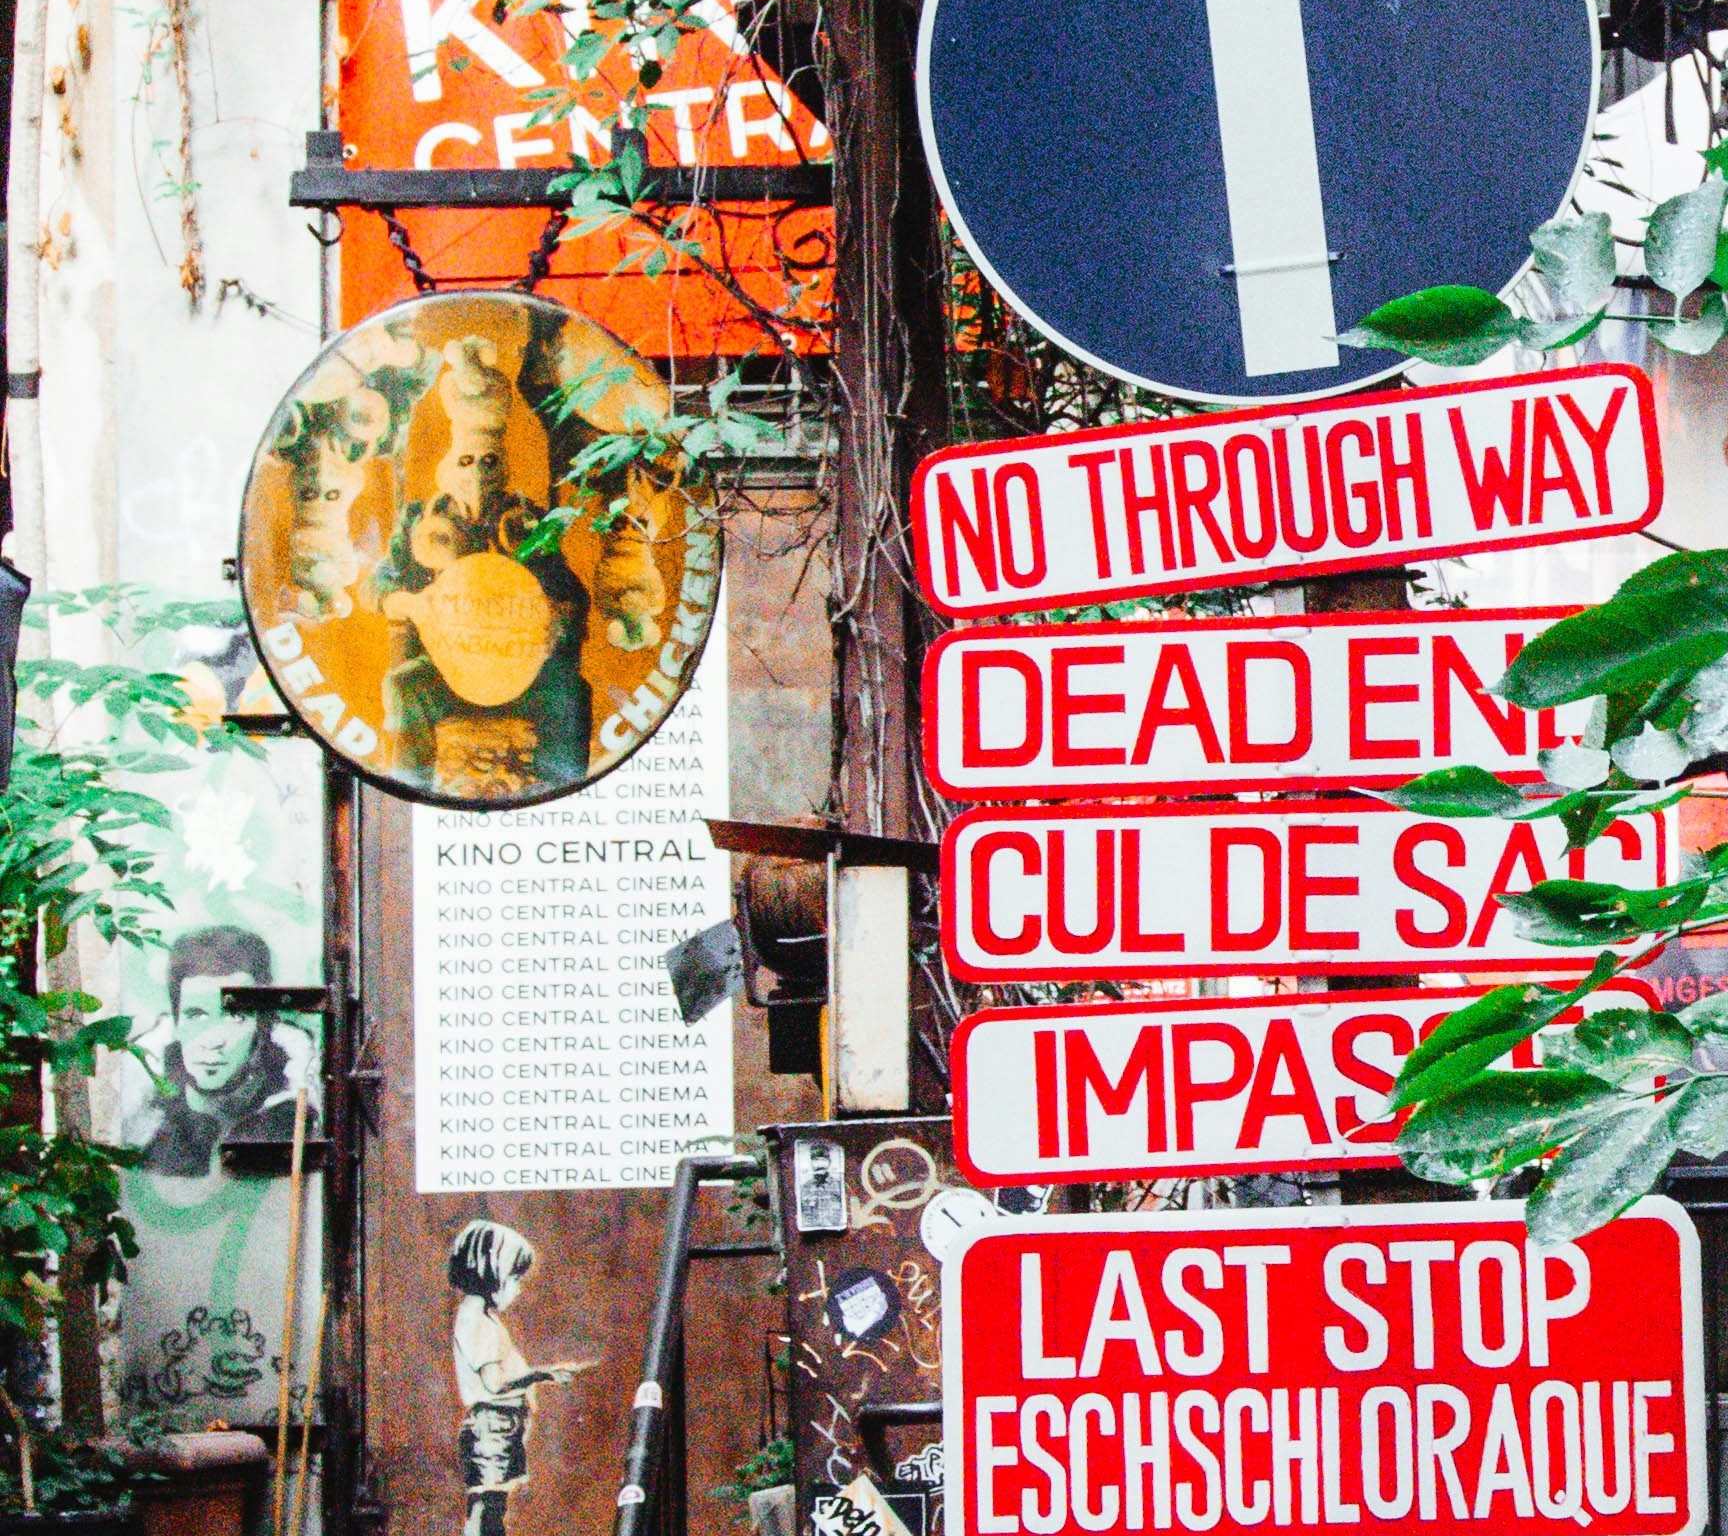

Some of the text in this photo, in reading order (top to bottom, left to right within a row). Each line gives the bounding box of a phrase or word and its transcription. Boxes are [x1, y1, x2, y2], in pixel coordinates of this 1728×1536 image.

[414, 79, 834, 171] CENTR
[935, 386, 1629, 598] NO THROUGH WAY
[264, 621, 378, 756] DEAD
[961, 641, 1312, 769] DEAD
[616, 783, 705, 799] CINEMA
[437, 808, 705, 829] KINO CENTRAL CINEMA
[437, 838, 706, 866] KINO CENTRAL
[438, 875, 705, 896] KINO CENTRAL CINEMA
[970, 827, 1185, 955] CUL
[1210, 824, 1361, 953] DE
[438, 901, 705, 922] KINO CENTRAL CINEMA
[439, 928, 701, 949] KINO CENTRAL CINEM
[439, 954, 667, 975] KINO CENTRAL CINE
[439, 980, 671, 1001] KINO CENTRAL CINE
[439, 1007, 708, 1028] KINO CENTRAL CINE
[440, 1033, 708, 1054] KINO CENTRAL CINEMA
[440, 1060, 708, 1081] KINO CENTRAL CINEMA
[1034, 1005, 1585, 1159] IMPAS
[440, 1086, 709, 1107] KINO CENTRAL CINEMA
[440, 1112, 709, 1133] KINO CENTRAL CINEMA
[441, 1144, 495, 1160] KINO
[503, 1142, 611, 1158] CENTRAL
[441, 1165, 671, 1186] KINO CENTRAL CINE
[1020, 1243, 1291, 1382] LAST
[1323, 1239, 1593, 1373] STOP
[974, 1380, 1677, 1536] ESCHSCHLORAQUE
